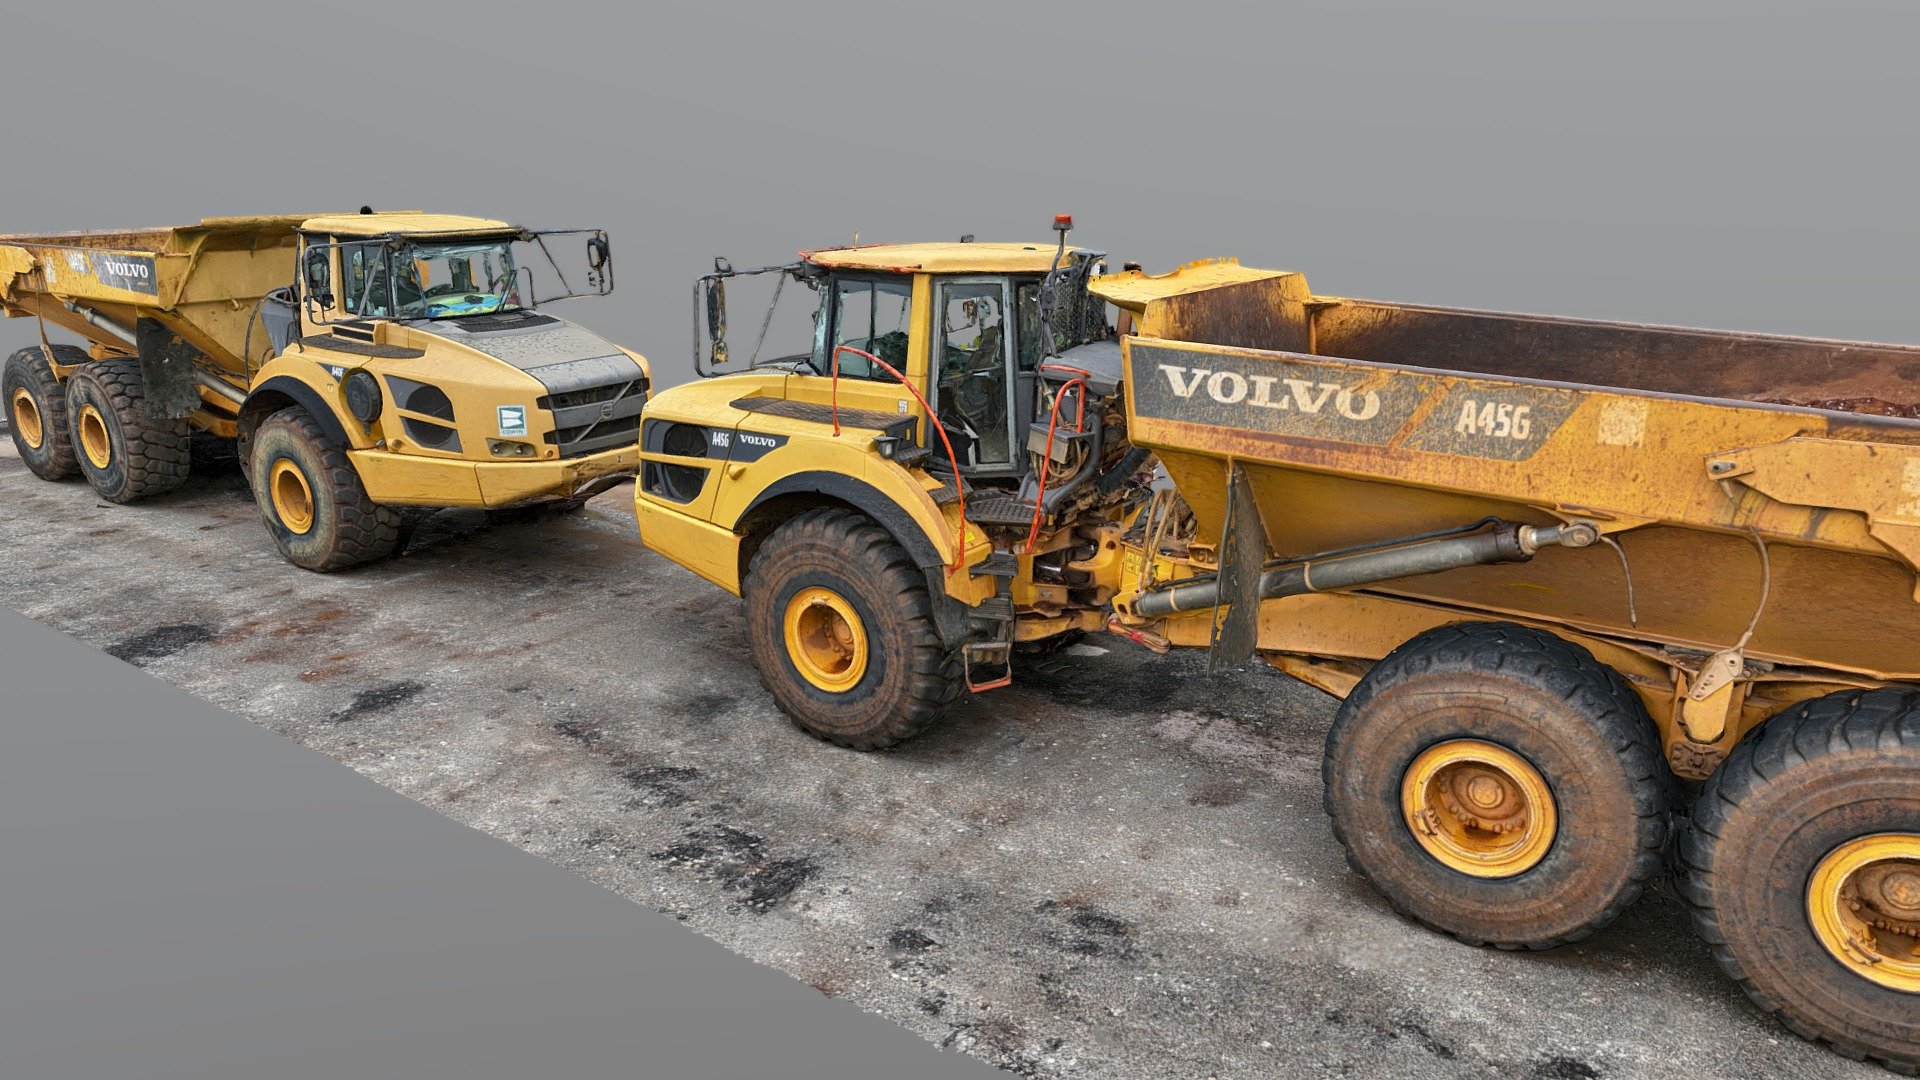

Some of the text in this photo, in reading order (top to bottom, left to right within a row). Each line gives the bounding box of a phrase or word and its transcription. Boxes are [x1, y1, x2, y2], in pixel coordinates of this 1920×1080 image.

[104, 261, 149, 278] VOLVO
[1158, 363, 1381, 421] VOLVO
[1455, 400, 1531, 440] A45G
[740, 434, 776, 448] VOLVO
